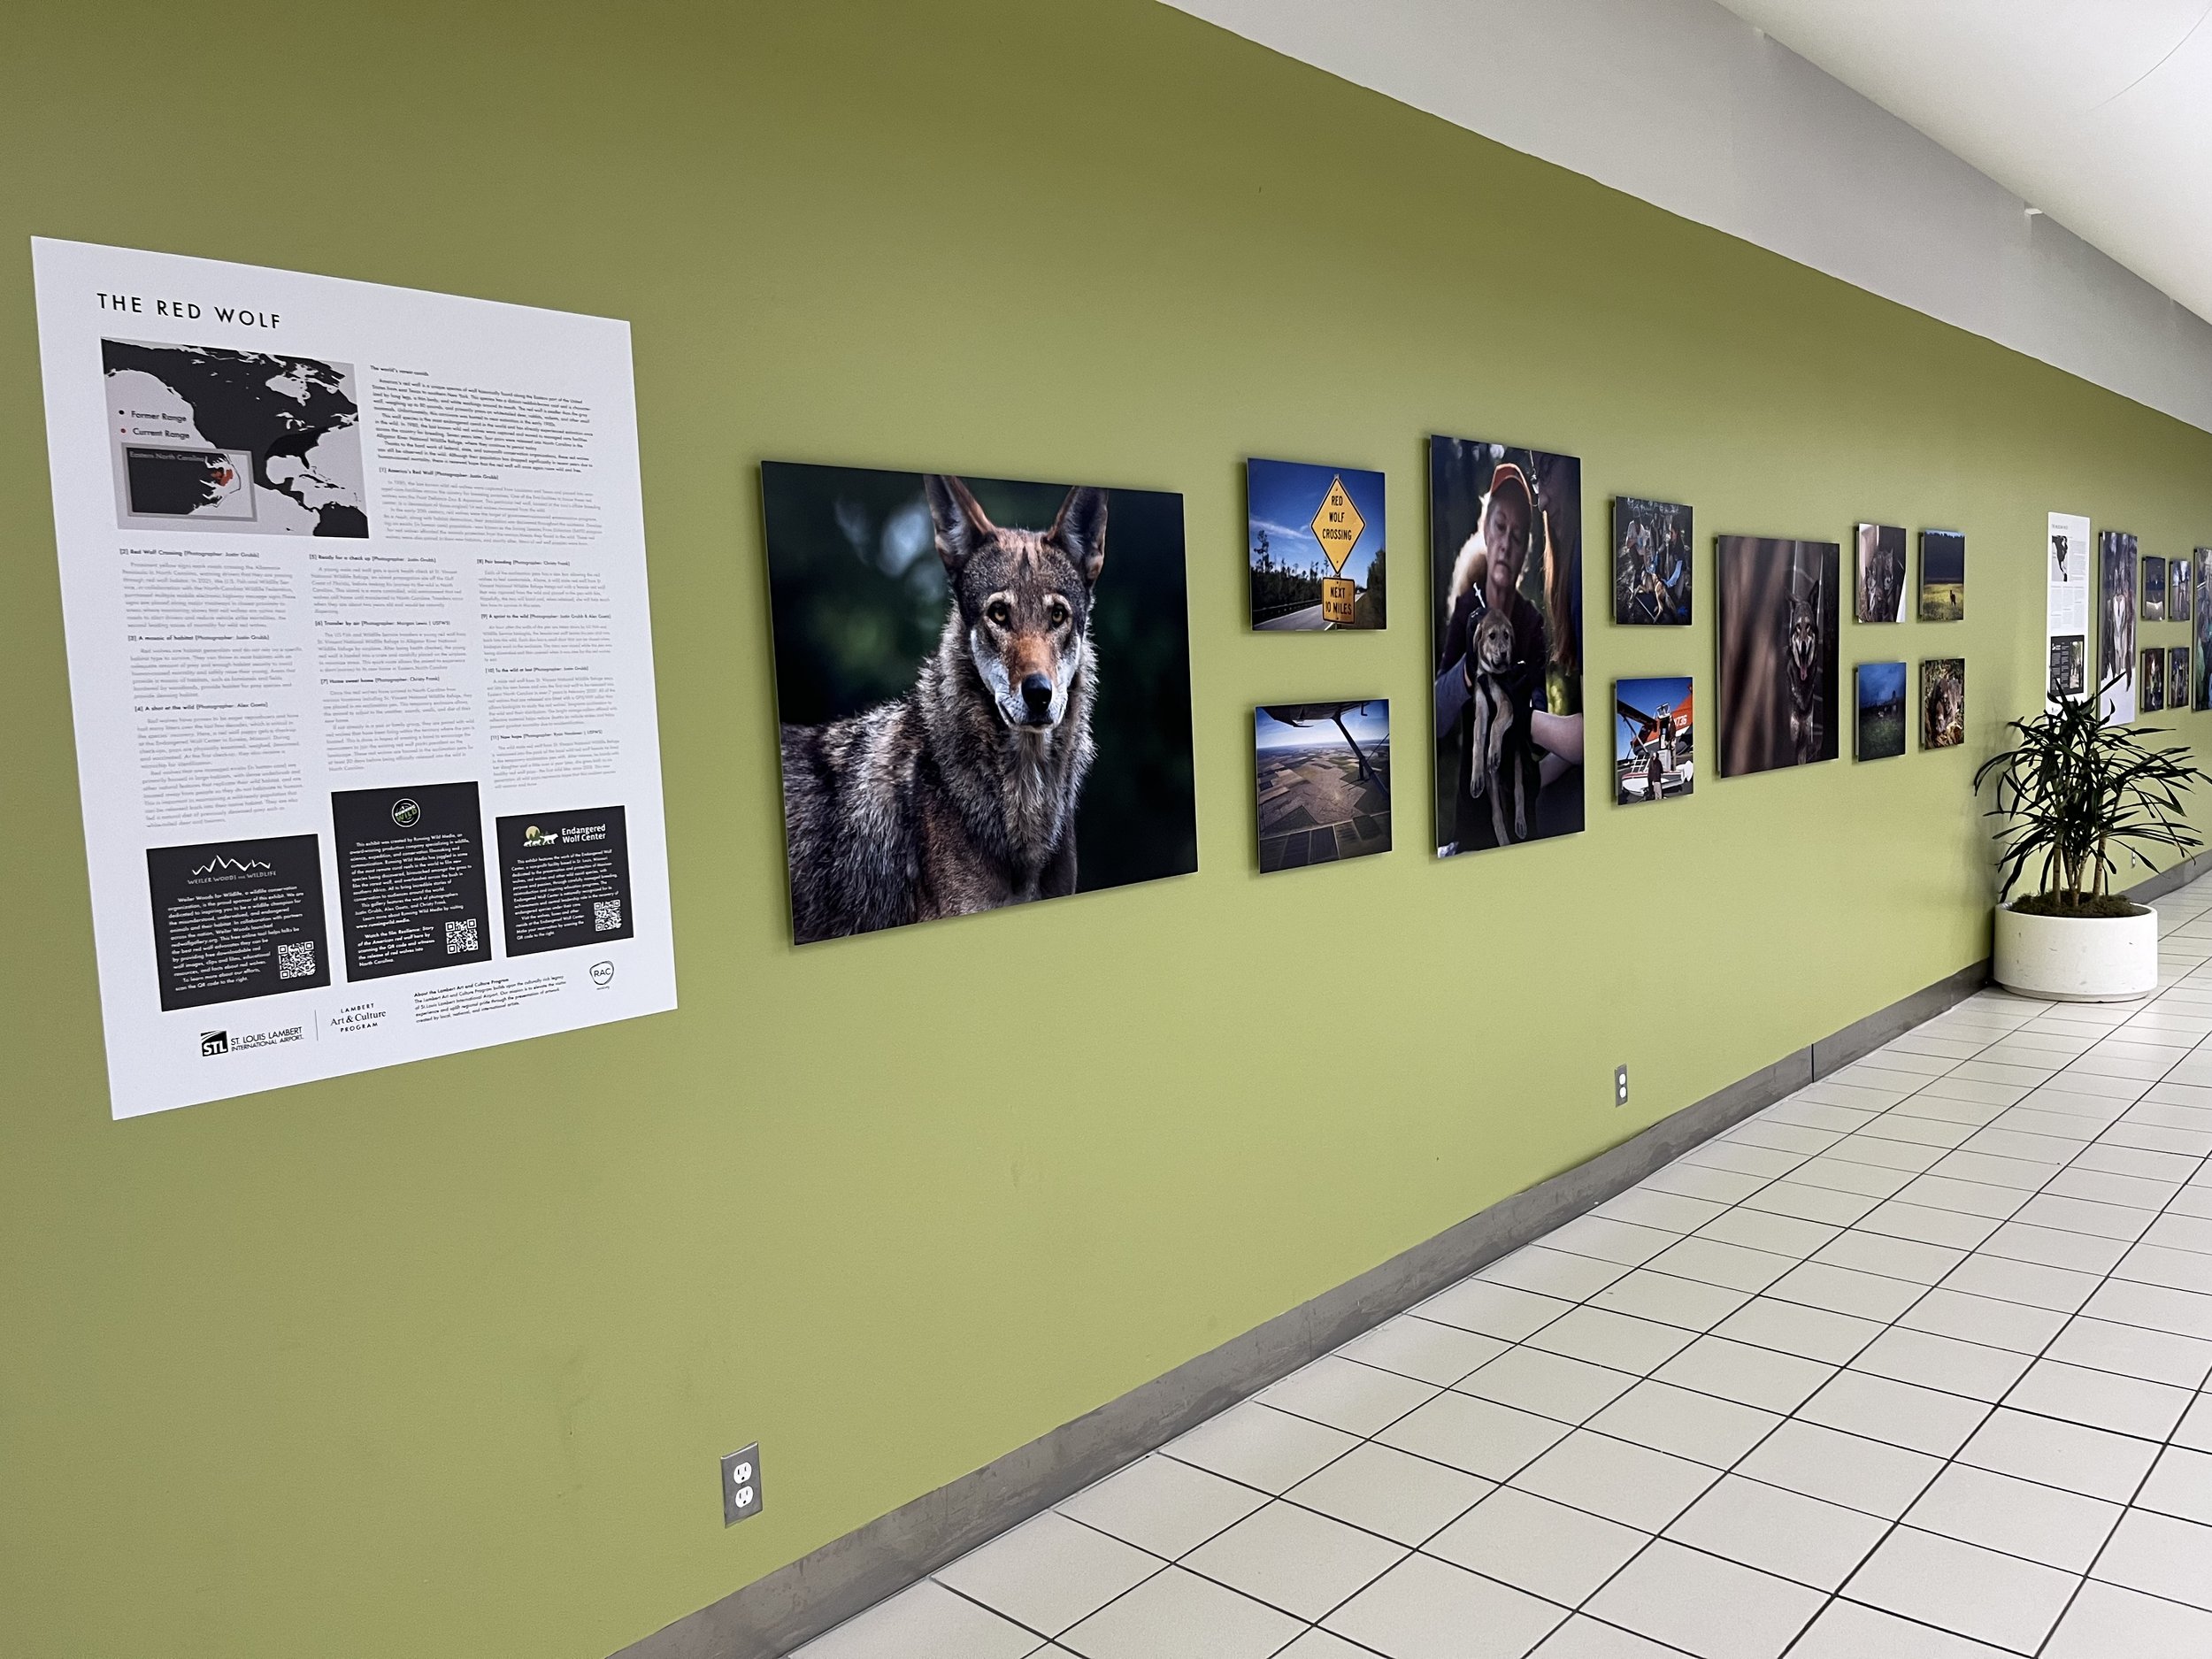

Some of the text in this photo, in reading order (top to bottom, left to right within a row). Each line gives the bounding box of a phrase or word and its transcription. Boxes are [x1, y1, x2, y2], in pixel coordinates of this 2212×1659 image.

[96, 292, 280, 329] THE RED WOLF
[130, 410, 187, 424] Former Range
[132, 426, 190, 441] Current Range
[175, 453, 205, 463] Carolina
[1332, 495, 1343, 506] RED
[1329, 511, 1345, 523] WOLF
[1322, 528, 1352, 541] CROSSING
[1330, 587, 1345, 599] NEXT
[1325, 601, 1352, 615] 10 MILES
[396, 809, 418, 822] WILD
[561, 823, 606, 835] Endangered
[562, 833, 606, 843] Wolf Center
[245, 870, 276, 879] WILDLIFE
[593, 967, 611, 977] RAC
[340, 1002, 374, 1014] LAMBERT
[329, 1010, 387, 1026] Art & Culture
[340, 1022, 378, 1033] PROGRAM
[242, 1032, 266, 1044] LOUIS
[267, 1025, 302, 1040] LAMBERT
[203, 1040, 227, 1056] STL
[230, 1039, 278, 1052] INTERNATIONAL
